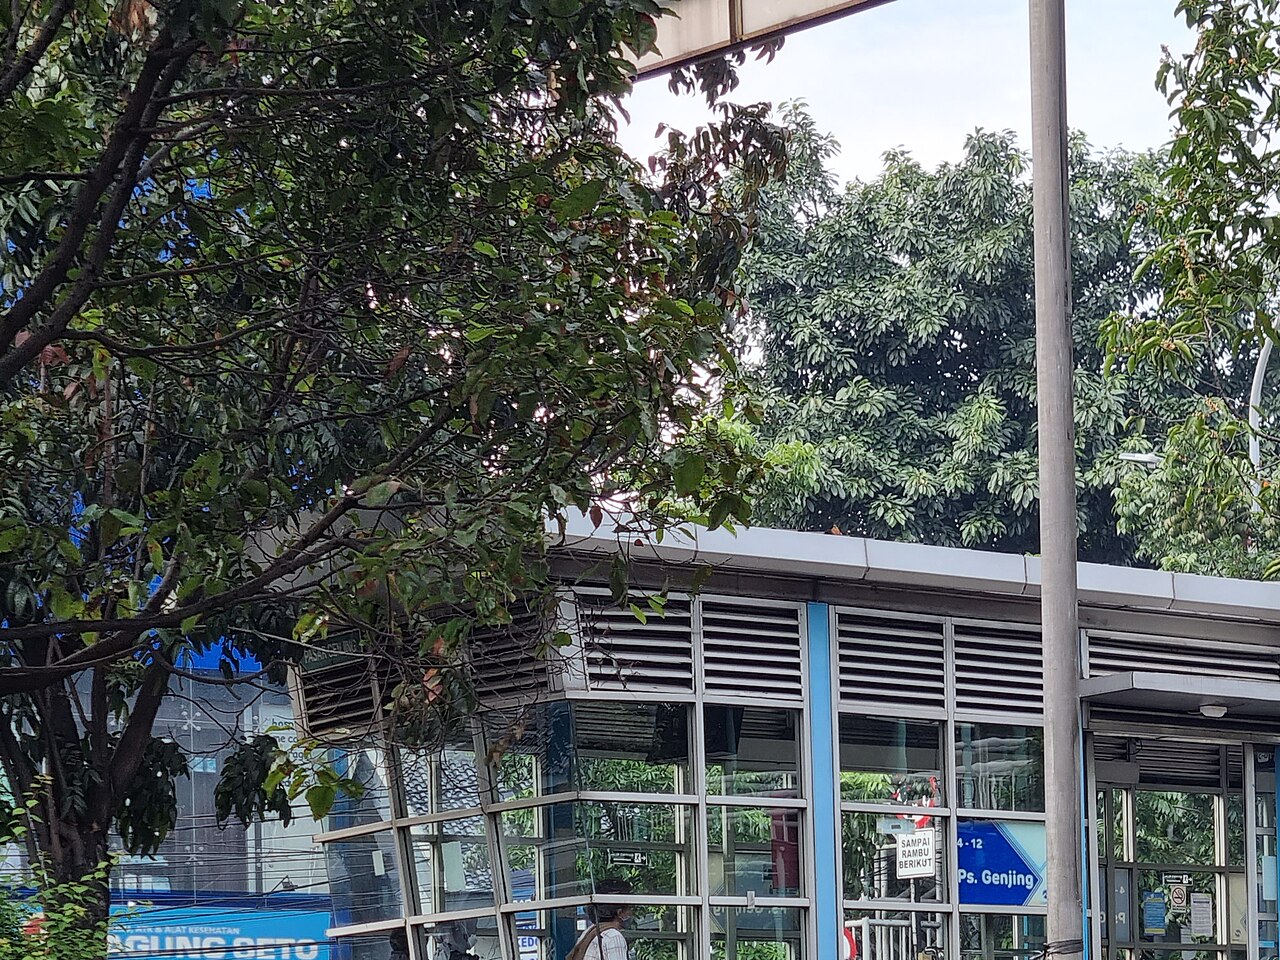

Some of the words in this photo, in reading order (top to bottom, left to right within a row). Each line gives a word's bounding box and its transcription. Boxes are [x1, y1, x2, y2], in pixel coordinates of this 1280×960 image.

[901, 837, 930, 849] SAMPAI
[970, 839, 983, 849] 12
[901, 848, 929, 859] RAMBU
[898, 858, 932, 869] BERIKUT
[957, 868, 978, 884] Ps.
[981, 869, 1034, 890] Genjing
[188, 926, 241, 936] KESEHATAN
[232, 937, 320, 960] SETO
